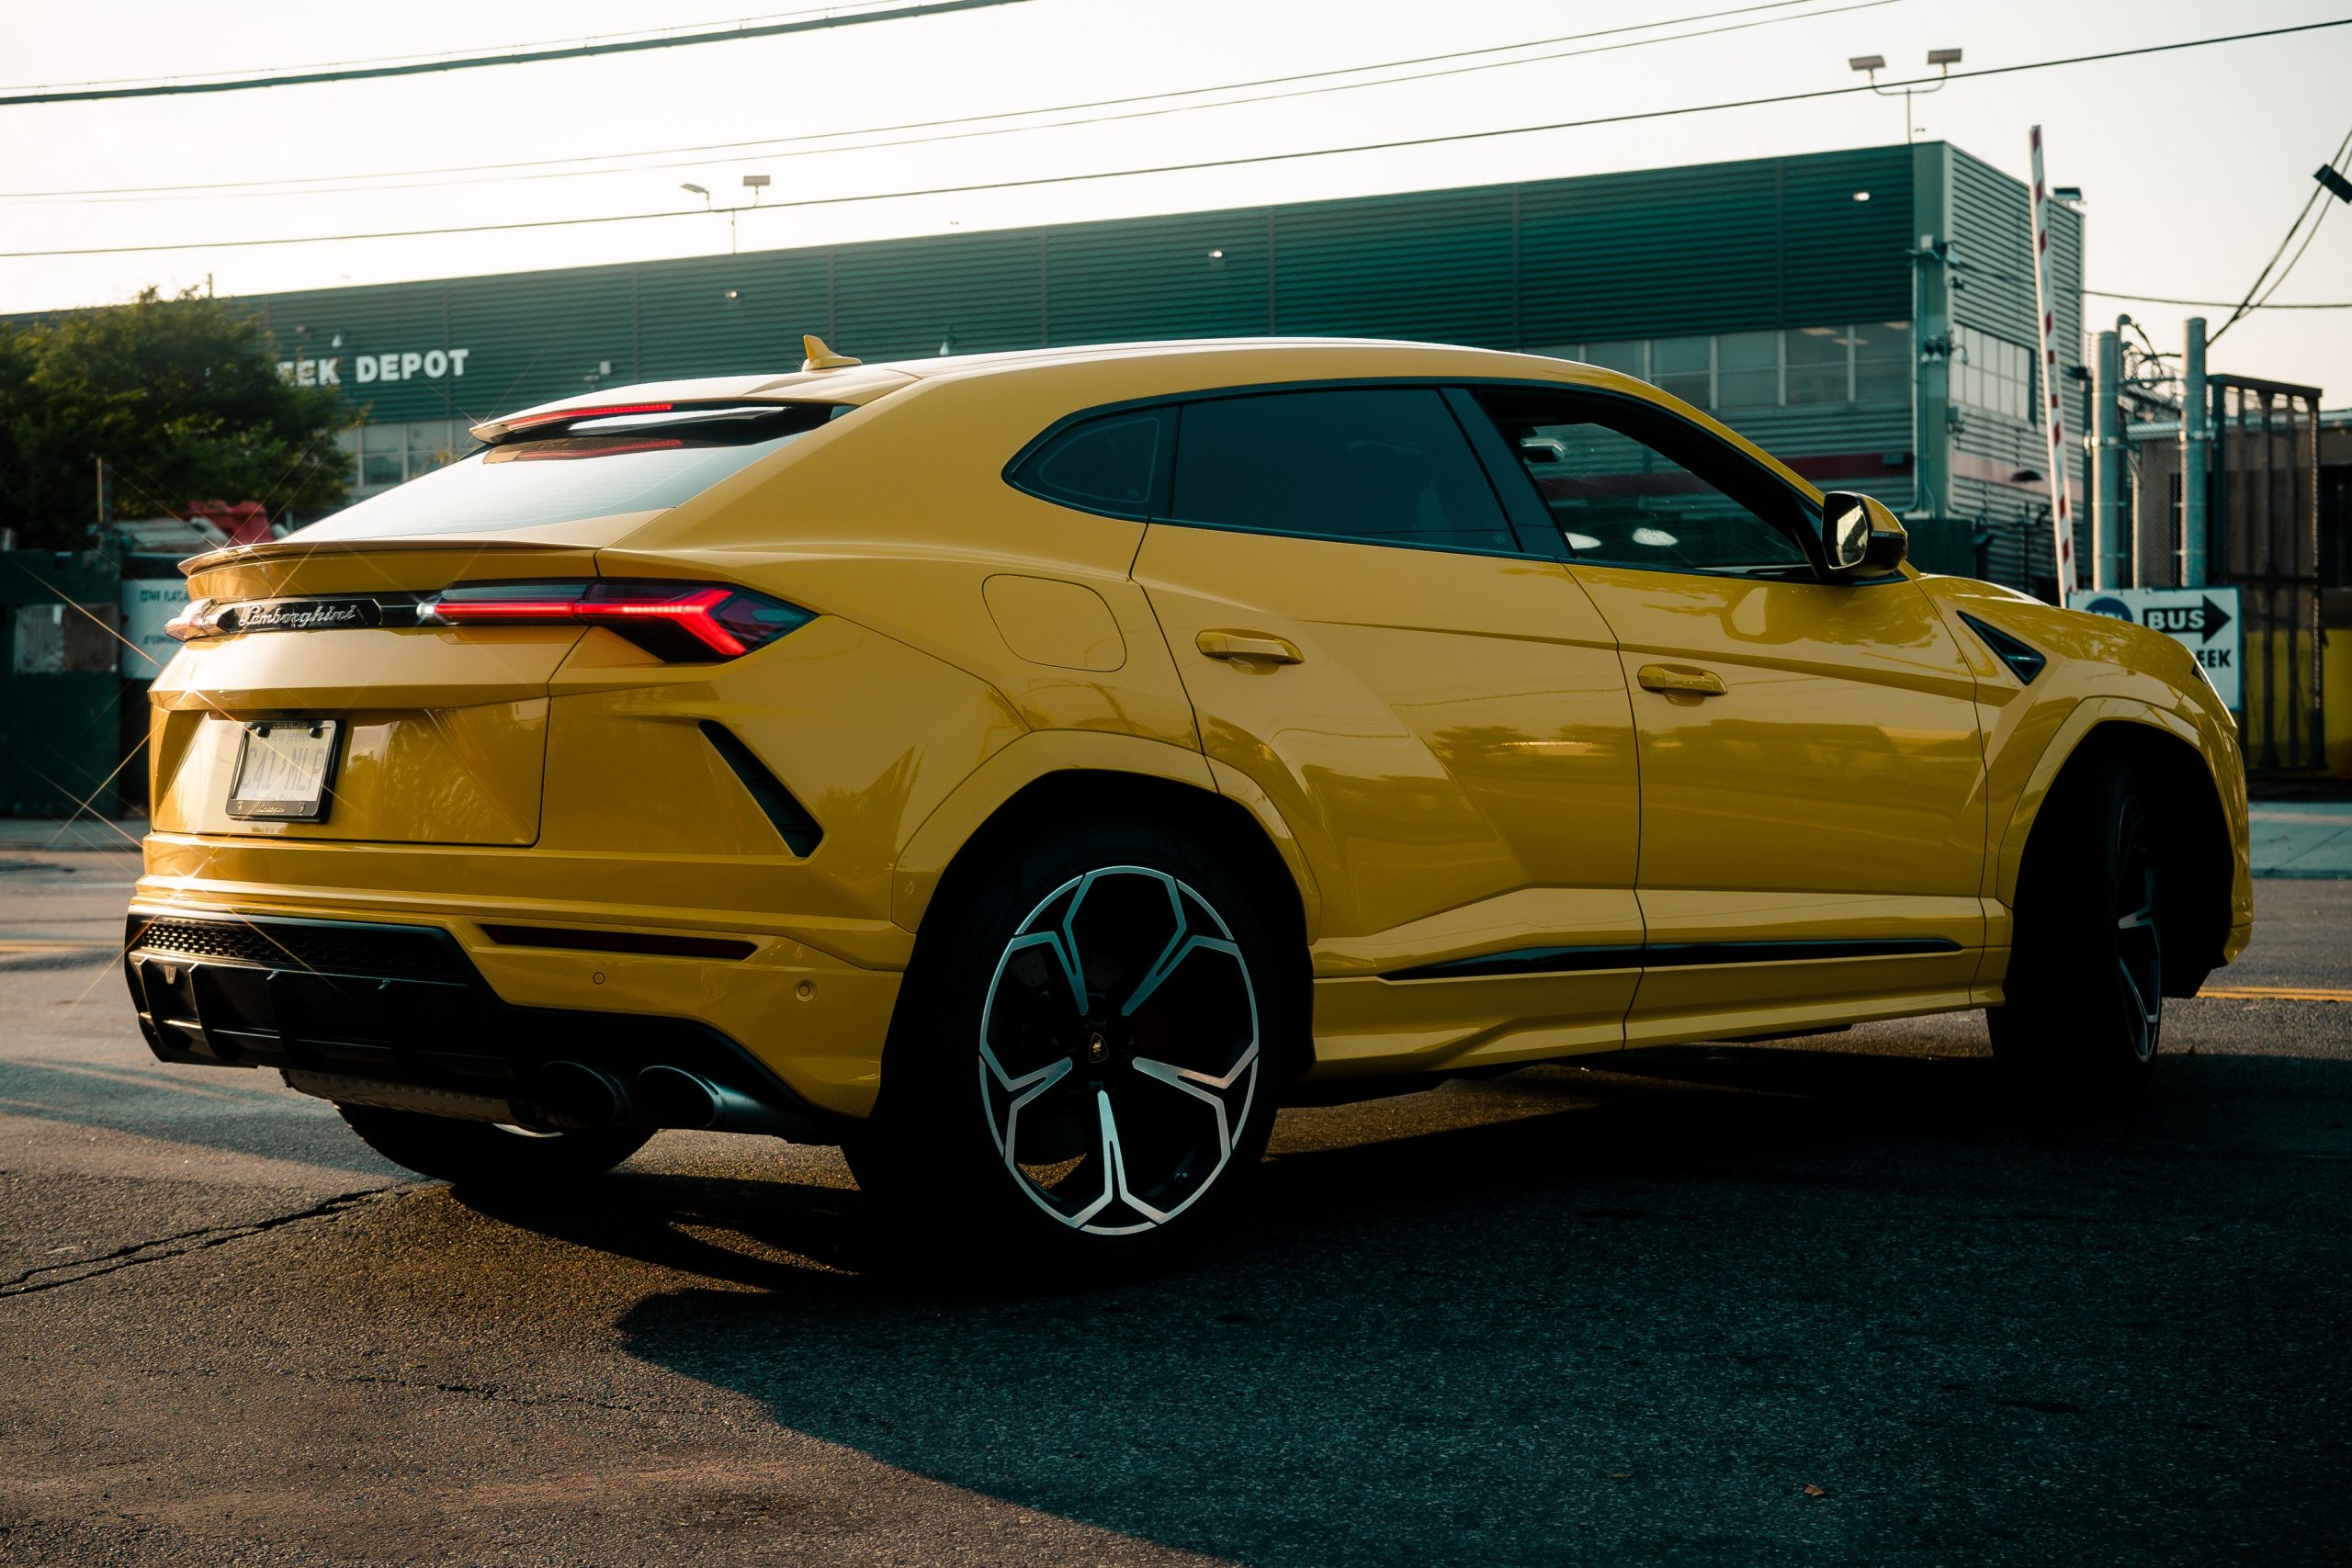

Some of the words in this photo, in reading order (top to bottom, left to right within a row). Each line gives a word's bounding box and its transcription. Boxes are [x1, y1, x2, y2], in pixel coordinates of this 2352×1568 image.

[356, 348, 469, 384] DEPOT
[239, 604, 356, 628] Lamborghini
[2147, 609, 2205, 630] BUS
